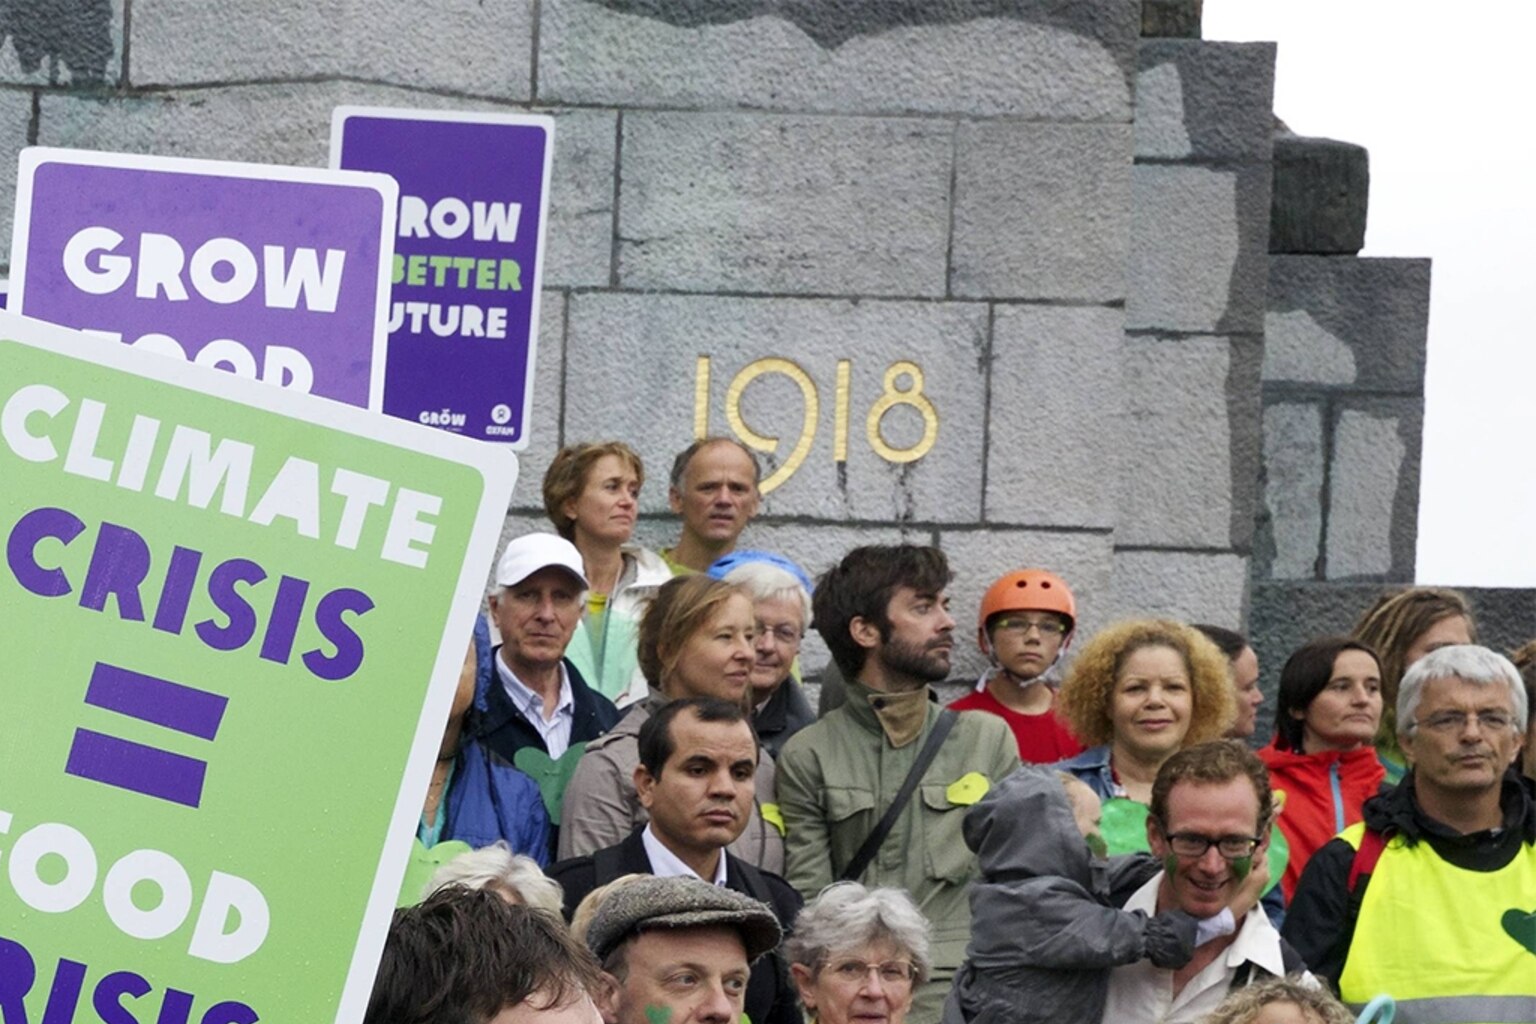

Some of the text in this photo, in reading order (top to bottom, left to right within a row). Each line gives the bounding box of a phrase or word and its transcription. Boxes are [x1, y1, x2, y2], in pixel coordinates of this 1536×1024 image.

[64, 227, 345, 313] GROW
[399, 196, 522, 243] ROW
[419, 408, 466, 426] GROW
[693, 355, 939, 495] 1918
[1, 385, 443, 570] CLIMATE
[6, 507, 375, 681] CRISIS
